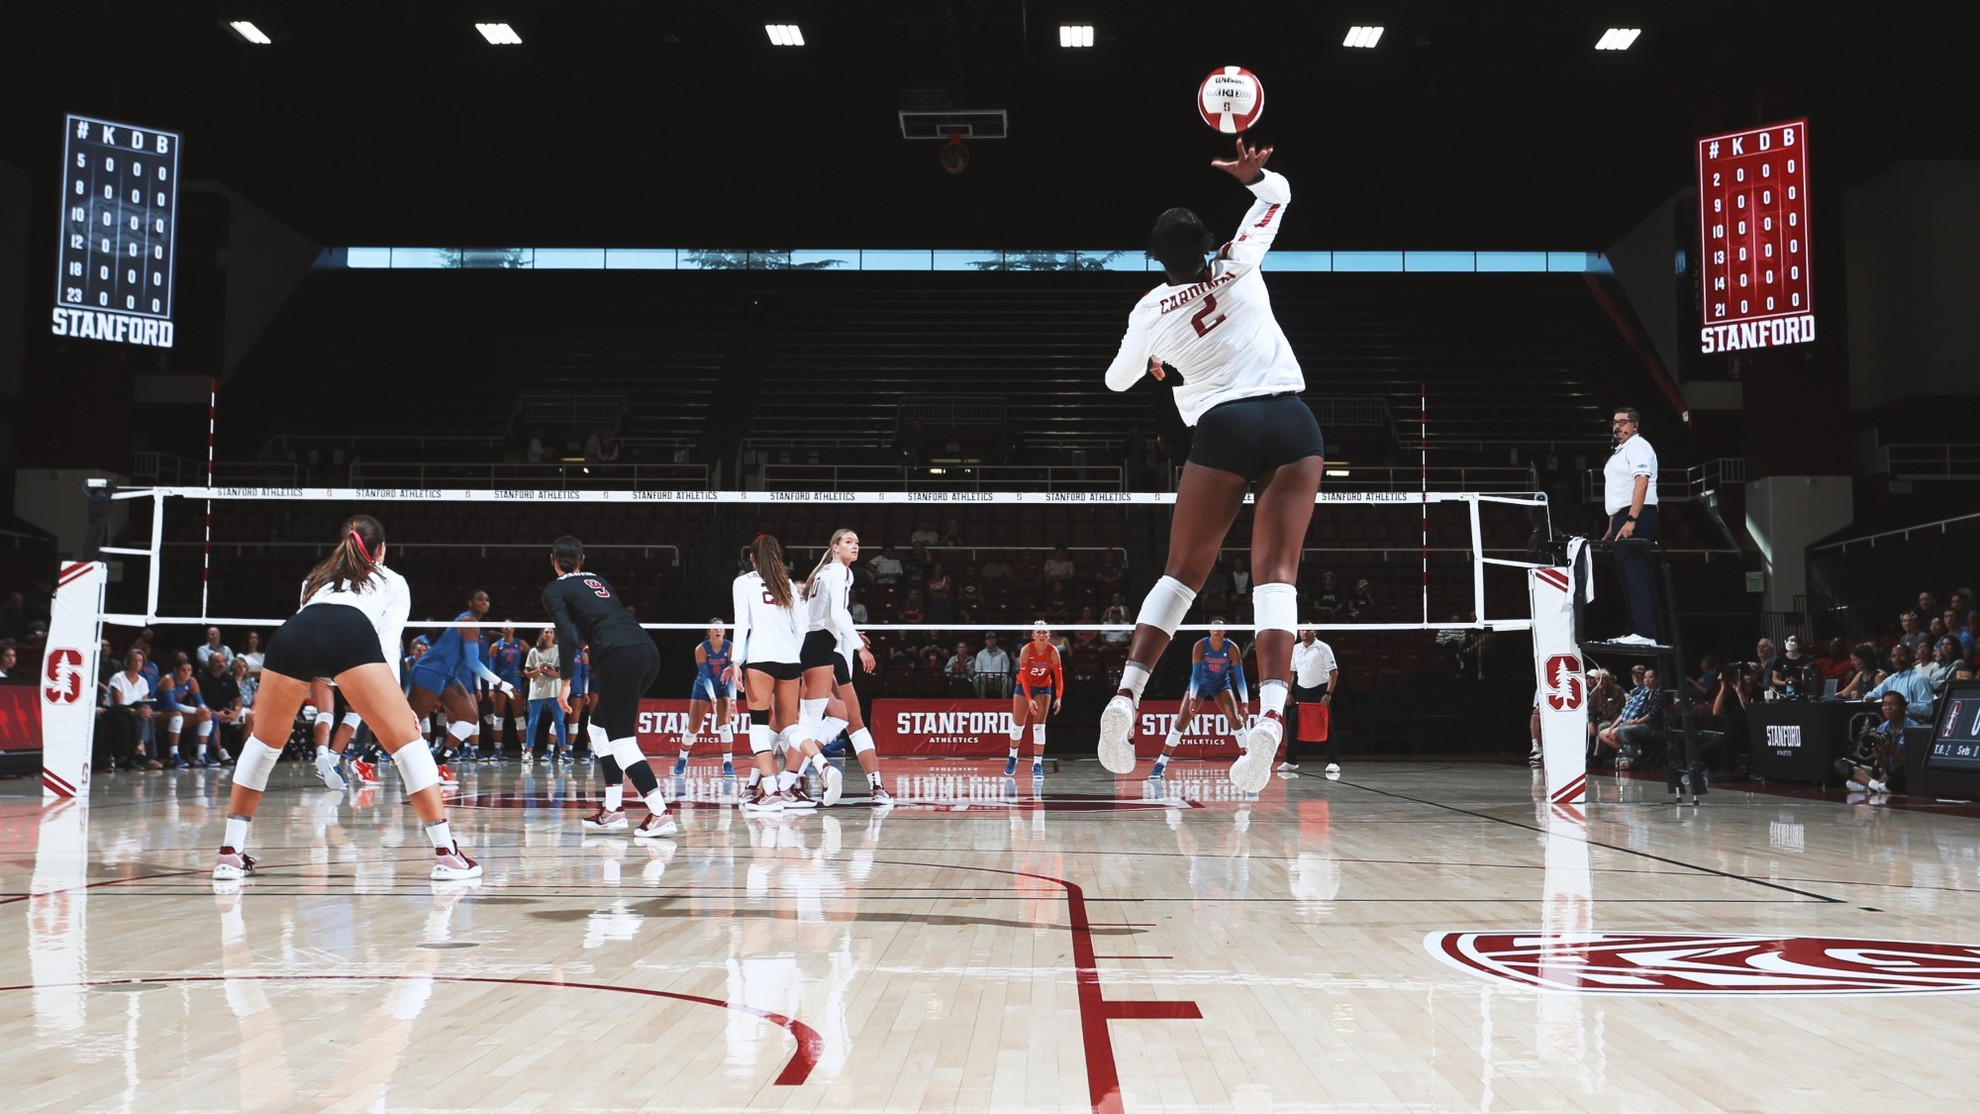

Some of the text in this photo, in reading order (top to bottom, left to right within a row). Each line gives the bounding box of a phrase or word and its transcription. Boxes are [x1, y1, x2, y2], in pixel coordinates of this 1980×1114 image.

[77, 121, 168, 154] # K D B
[1709, 128, 1795, 159] # K D B
[77, 153, 166, 181] 5 0 0 0
[1713, 159, 1795, 187] 2 0 0 0
[76, 180, 165, 207] 8 0 0 0
[1714, 186, 1796, 212] 9 0 0 0
[72, 207, 164, 233] 10 0 0 0
[1712, 212, 1797, 239] 10 0 0 0
[71, 235, 162, 260] 12 0 0 0
[1714, 239, 1798, 264] 13 0 0 0
[69, 262, 161, 286] 18 0 0 0
[1715, 266, 1799, 290] 14 0 0 0
[67, 288, 160, 312] 23 0 0 0
[1715, 292, 1799, 317] 21 0 0 0
[52, 308, 173, 347] STANFORD
[1190, 293, 1227, 338] 2
[1701, 315, 1816, 353] STANFORD
[217, 488, 257, 497] STANFORD
[261, 488, 303, 497] ATHLETICS
[355, 489, 396, 498] STANFORD
[400, 489, 442, 498] ATHLETICS
[494, 490, 534, 499] STANFORD
[538, 490, 580, 499] ATHLETICS
[632, 491, 672, 500] STANFORD
[676, 491, 718, 500] ATHLETICS
[770, 492, 810, 500] STANFORD
[814, 492, 855, 500] ATHLETICS
[907, 492, 948, 501] STANFORD
[952, 492, 993, 501] ATHLETICS
[1045, 492, 1086, 501] STANFORD
[1090, 492, 1131, 501] ATHLETICS
[1321, 492, 1362, 501] STANFORD
[1365, 492, 1407, 501] ATHLETICS
[584, 579, 610, 598] 9
[1030, 667, 1047, 676] 23
[897, 712, 1013, 734] STANFORD
[1142, 713, 1259, 736] STNFOD
[1766, 725, 1801, 747] STANFORD
[1957, 745, 1971, 756] Sets
